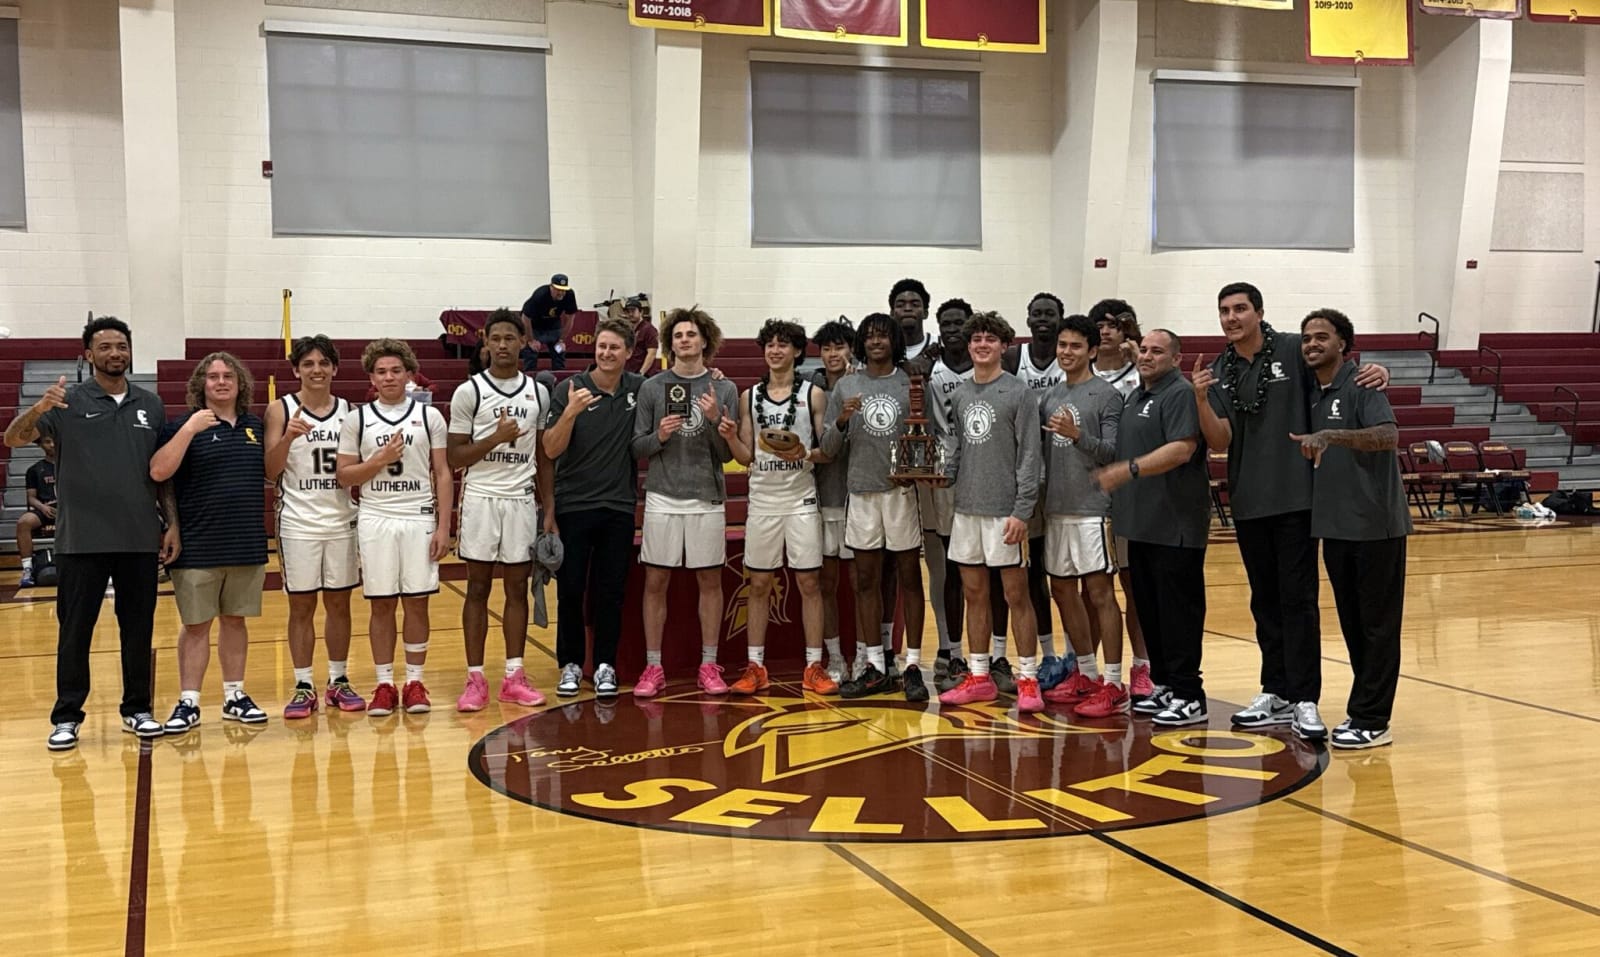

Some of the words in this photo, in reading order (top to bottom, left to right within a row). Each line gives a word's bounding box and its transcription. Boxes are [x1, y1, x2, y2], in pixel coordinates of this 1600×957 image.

[641, 4, 692, 17] 2017-2018
[1314, 1, 1354, 10] 2019-2020
[305, 430, 341, 443] CREAN
[376, 433, 413, 447] CRN
[311, 447, 338, 475] 15
[484, 451, 529, 464] LUTHERAN
[759, 460, 804, 471] LUTHERAN
[299, 478, 338, 490] LUTHER
[370, 480, 421, 492] LUTHERAN
[571, 730, 1286, 834] SELLITTO
